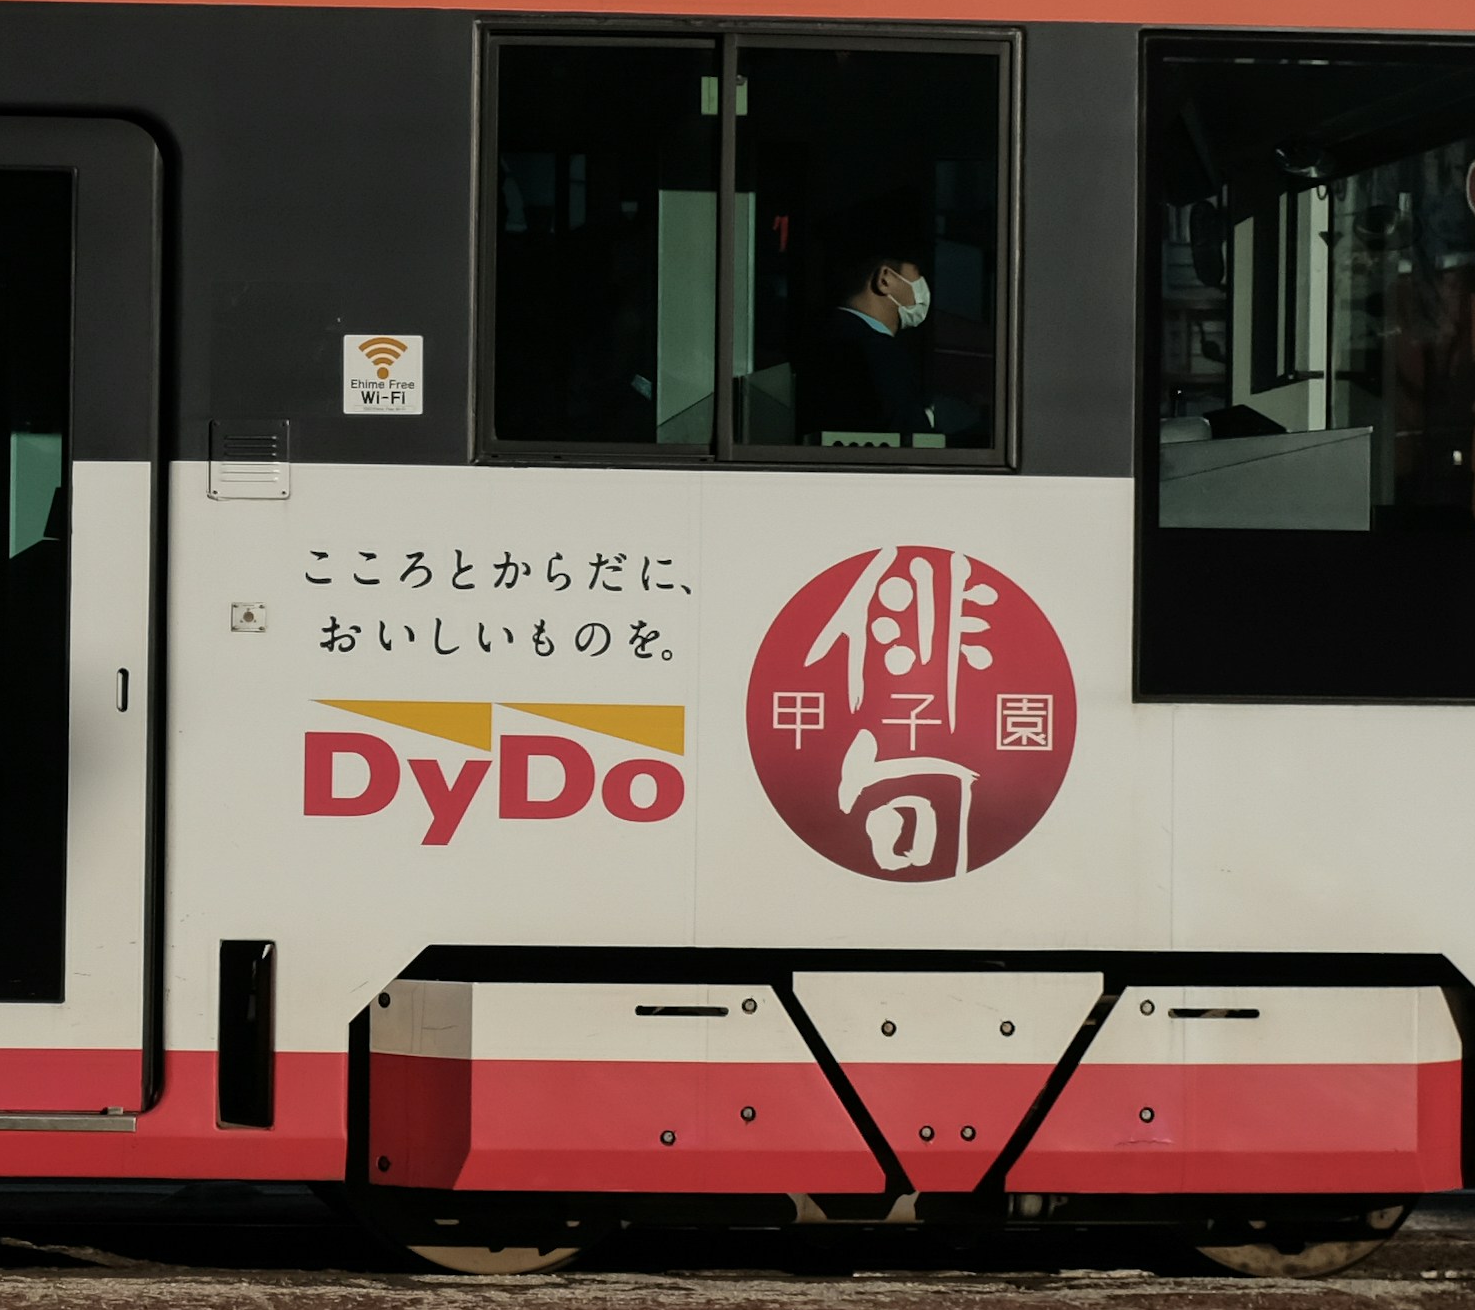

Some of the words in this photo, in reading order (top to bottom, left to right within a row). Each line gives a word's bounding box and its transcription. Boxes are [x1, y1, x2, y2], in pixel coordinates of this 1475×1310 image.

[350, 379, 385, 389] Ehime
[388, 380, 415, 390] Free
[361, 391, 406, 405] Wi-Fi
[305, 547, 693, 596] こころとからだに、
[319, 614, 675, 663] おいしいものを。
[303, 730, 686, 846] DyDo
